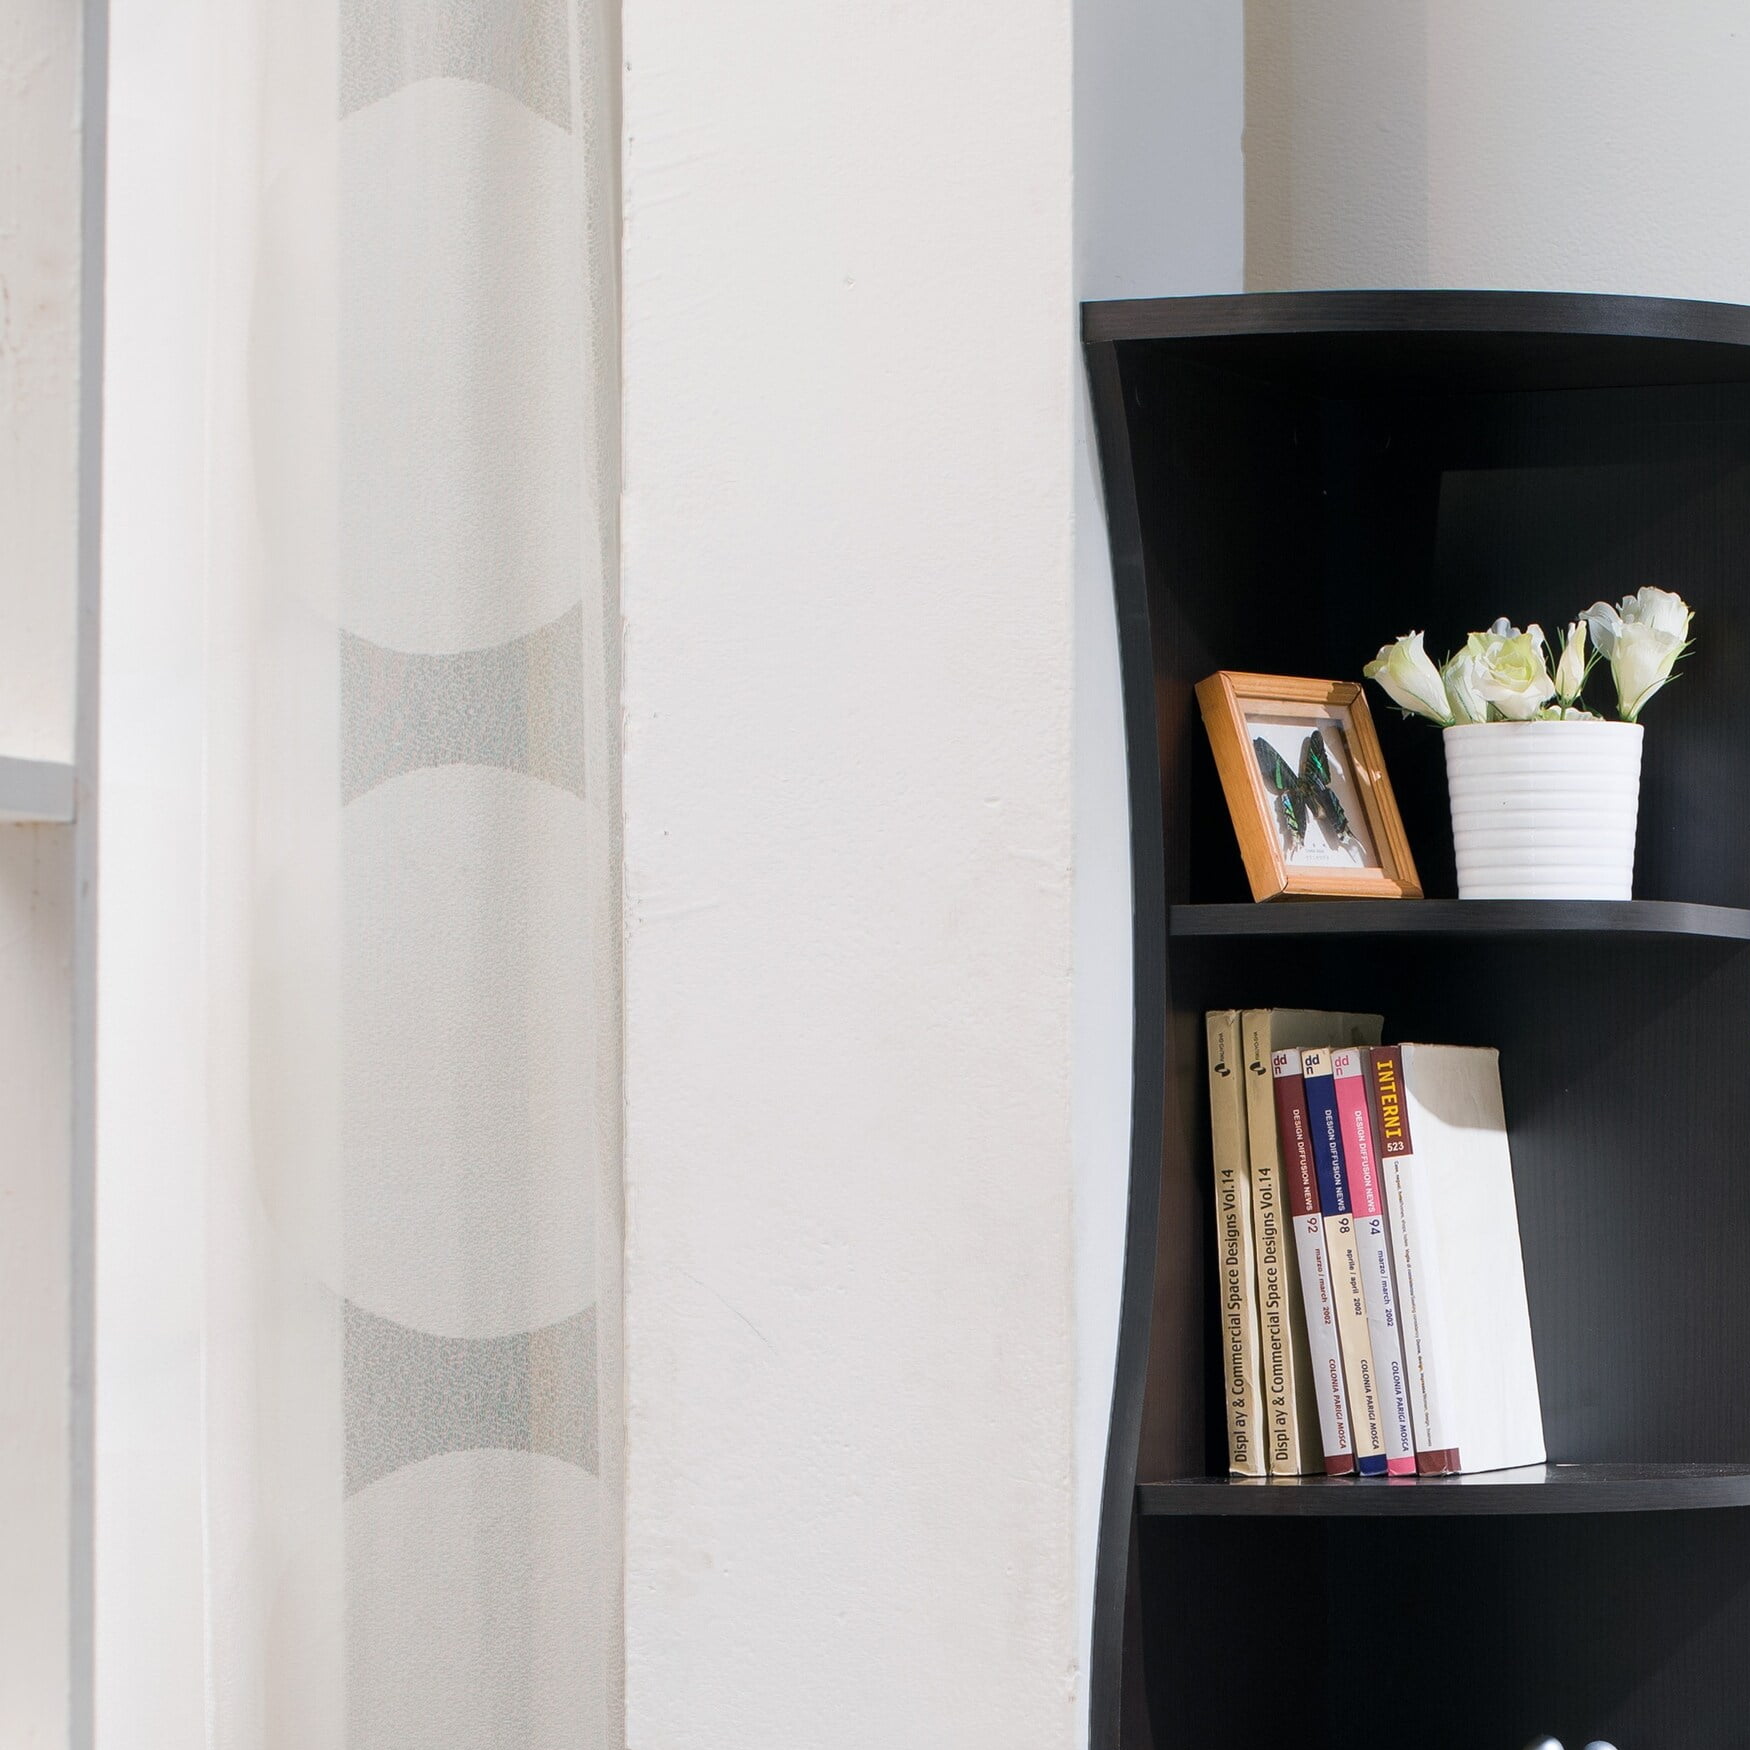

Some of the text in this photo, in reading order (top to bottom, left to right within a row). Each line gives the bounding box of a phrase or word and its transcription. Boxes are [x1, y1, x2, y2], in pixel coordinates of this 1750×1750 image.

[1377, 1060, 1402, 1138] INTERNI
[1293, 1109, 1304, 1139] DESIGN
[1325, 1109, 1336, 1140] DESIGN
[1355, 1110, 1366, 1141] DESIGN
[1387, 1142, 1405, 1152] 523
[1298, 1141, 1310, 1184] DIFFUSION
[1330, 1141, 1342, 1185] DIFFUSION
[1360, 1142, 1372, 1186] DIFFUSION
[1221, 1169, 1236, 1211] Vol.14
[1259, 1167, 1273, 1209] Vol.14
[1304, 1186, 1313, 1210] NEWS
[1336, 1186, 1346, 1211] NEWS
[1366, 1188, 1376, 1212] NEWS
[1262, 1212, 1278, 1263] Designs
[1307, 1218, 1318, 1233] 92
[1339, 1218, 1350, 1233] 98
[1370, 1219, 1381, 1235] 94
[1225, 1213, 1240, 1265] Designs
[1347, 1249, 1356, 1270] aprile
[1378, 1250, 1386, 1274] marzo
[1228, 1269, 1243, 1310] Space
[1266, 1267, 1281, 1307] Space
[1320, 1278, 1328, 1302] march
[1350, 1276, 1359, 1293] april
[1382, 1280, 1391, 1304] march
[1323, 1306, 1332, 1324] 2002
[1354, 1297, 1363, 1315] 2002
[1386, 1308, 1394, 1326] 2002
[1229, 1313, 1245, 1394] Commercial
[1267, 1311, 1284, 1393] Commercial
[1329, 1358, 1339, 1392] COLONIA
[1361, 1359, 1372, 1393] COLONIA
[1392, 1361, 1402, 1394] COLONIA
[1232, 1398, 1245, 1407] &
[1272, 1396, 1285, 1405] &
[1334, 1394, 1343, 1419] PARIGI
[1366, 1395, 1376, 1420] PARIGI
[1396, 1397, 1406, 1422] PARIGI
[1338, 1422, 1347, 1448] MOSCA
[1370, 1422, 1380, 1449] MOSCA
[1400, 1424, 1409, 1451] MOSCA
